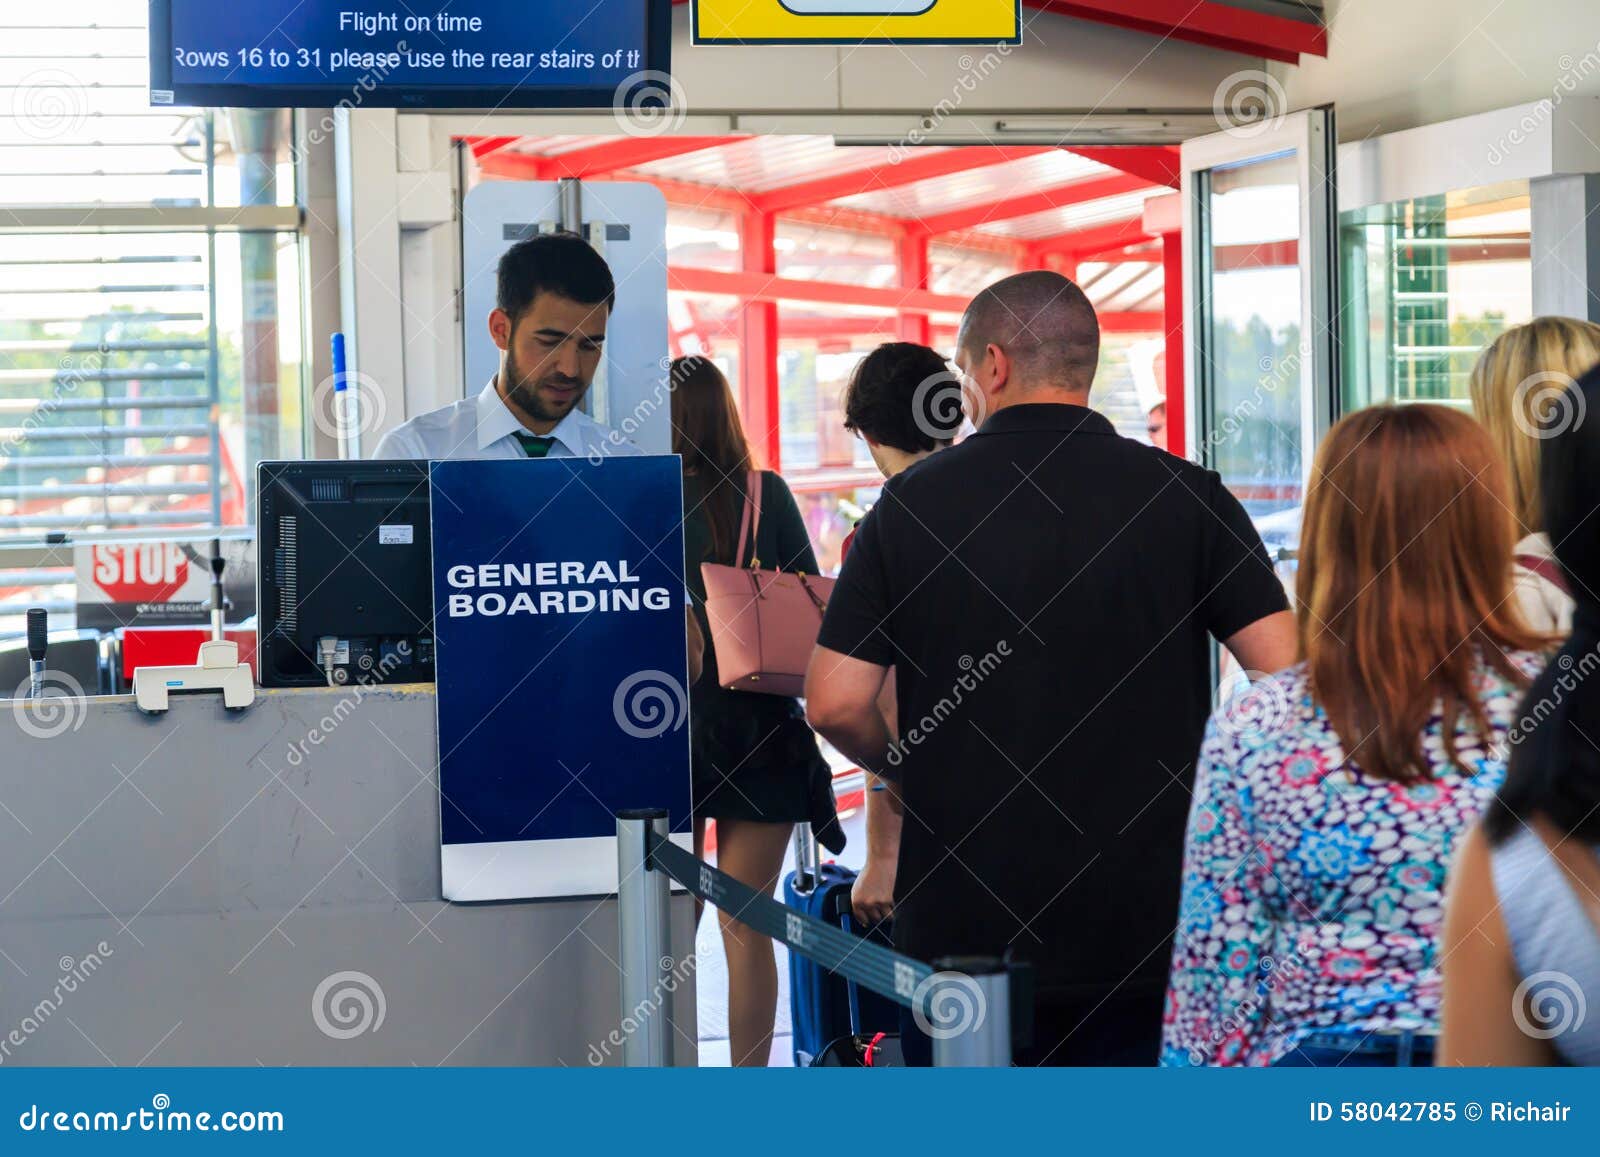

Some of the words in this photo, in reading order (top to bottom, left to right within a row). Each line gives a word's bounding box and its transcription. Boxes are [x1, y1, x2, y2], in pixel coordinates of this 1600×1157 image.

[339, 11, 398, 36] Flight
[404, 16, 431, 32] on
[437, 13, 482, 32] time
[174, 47, 229, 67] Rows
[237, 48, 263, 67] 16
[269, 49, 290, 67] to
[296, 48, 321, 67] 31
[330, 48, 401, 72] please
[407, 51, 446, 68] use
[451, 49, 485, 68] the
[491, 52, 534, 68] rear
[538, 49, 595, 68] stairs
[601, 49, 622, 68] of
[95, 543, 188, 585] STOP
[447, 559, 640, 588] GENERAL
[448, 587, 671, 618] BOARDING
